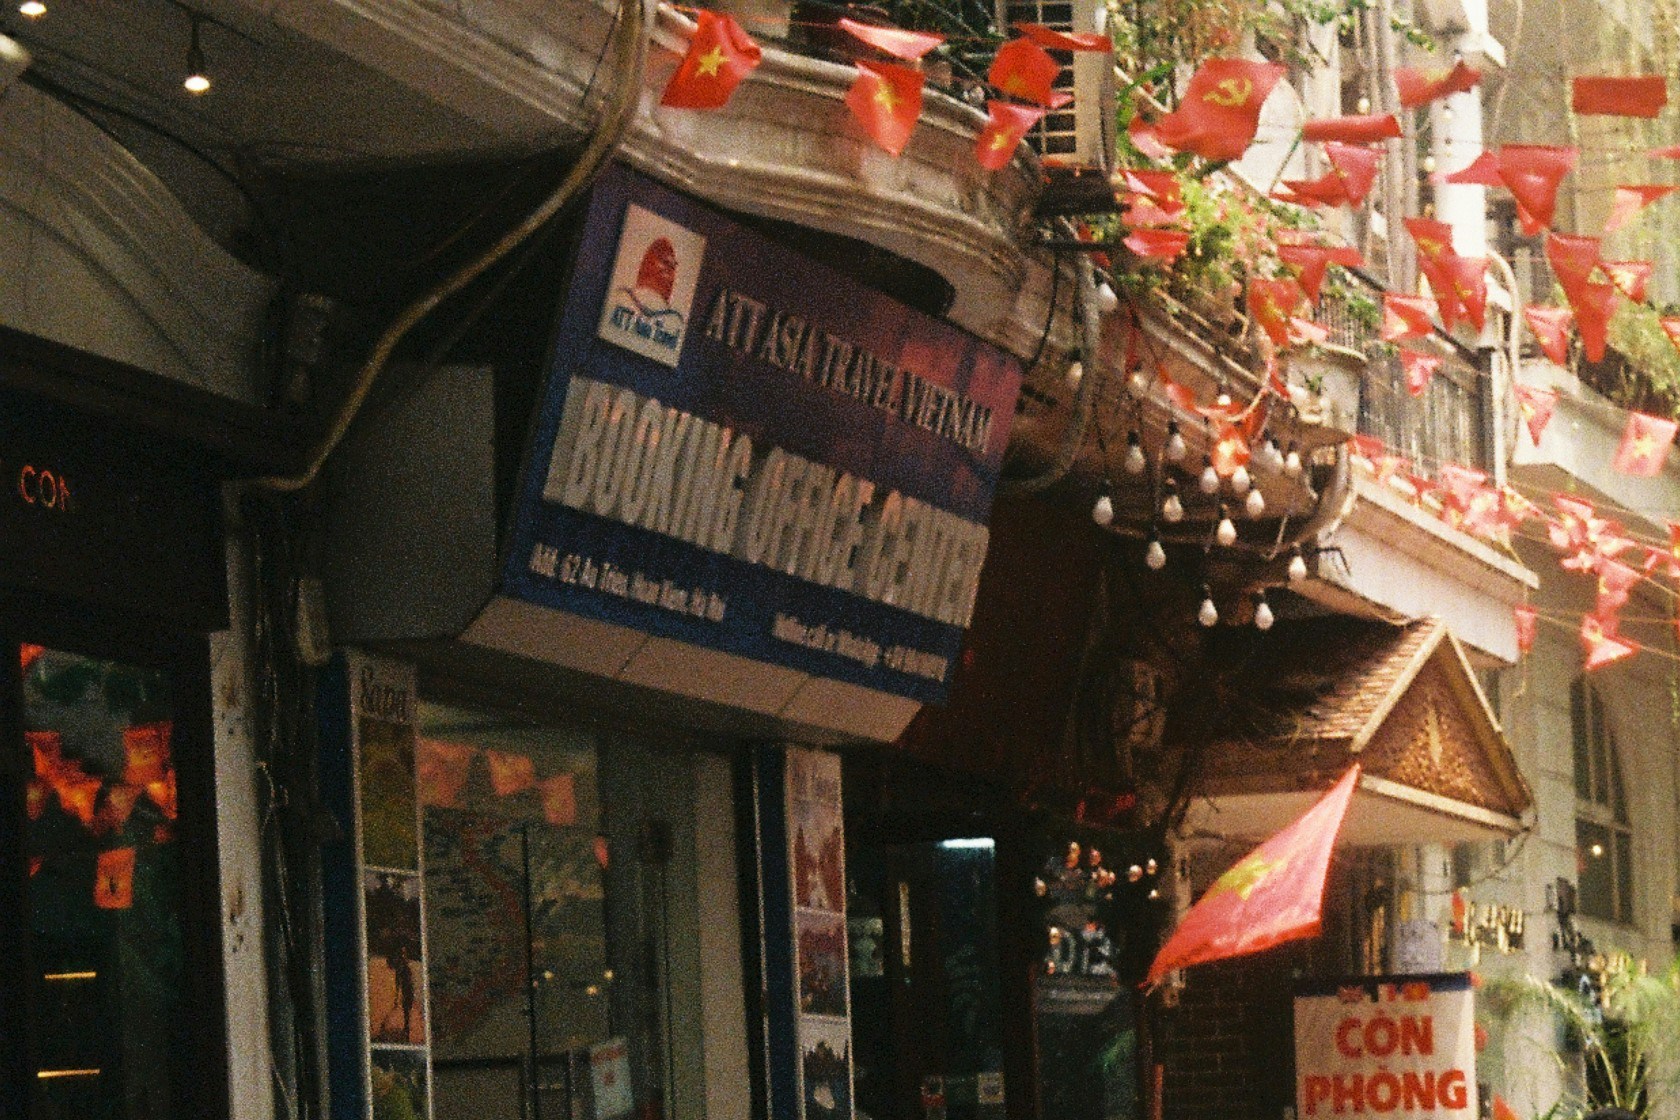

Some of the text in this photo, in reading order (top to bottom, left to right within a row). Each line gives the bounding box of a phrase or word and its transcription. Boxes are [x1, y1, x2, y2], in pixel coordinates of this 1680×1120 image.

[706, 288, 992, 453] ATT ASIA TRAVEL VIETNAM
[552, 377, 990, 630] BOOKING OFFICE CENTER
[1335, 1008, 1433, 1059] CÒN
[1304, 1065, 1467, 1116] PHÒNG
